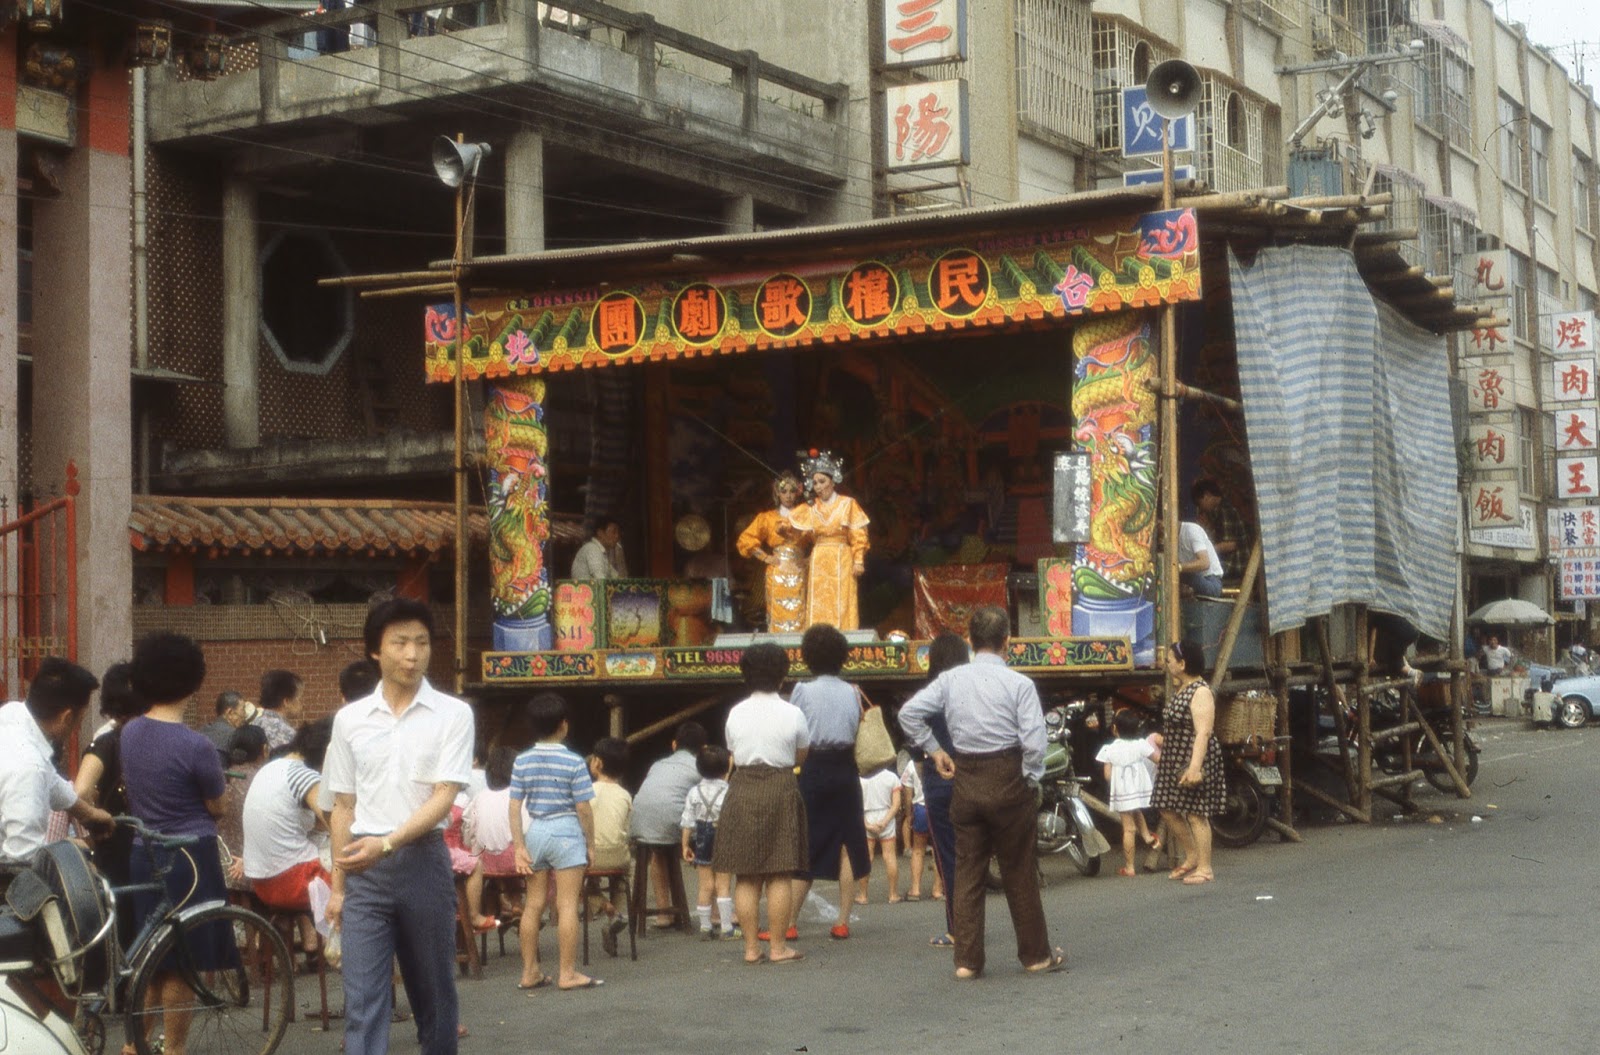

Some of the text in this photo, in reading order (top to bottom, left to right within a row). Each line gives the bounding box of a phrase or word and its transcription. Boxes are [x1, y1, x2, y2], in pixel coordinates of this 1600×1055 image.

[1054, 264, 1094, 314] 台
[507, 329, 540, 366] 北
[1580, 510, 1598, 545] 便當
[674, 650, 744, 664] TEL 9688
